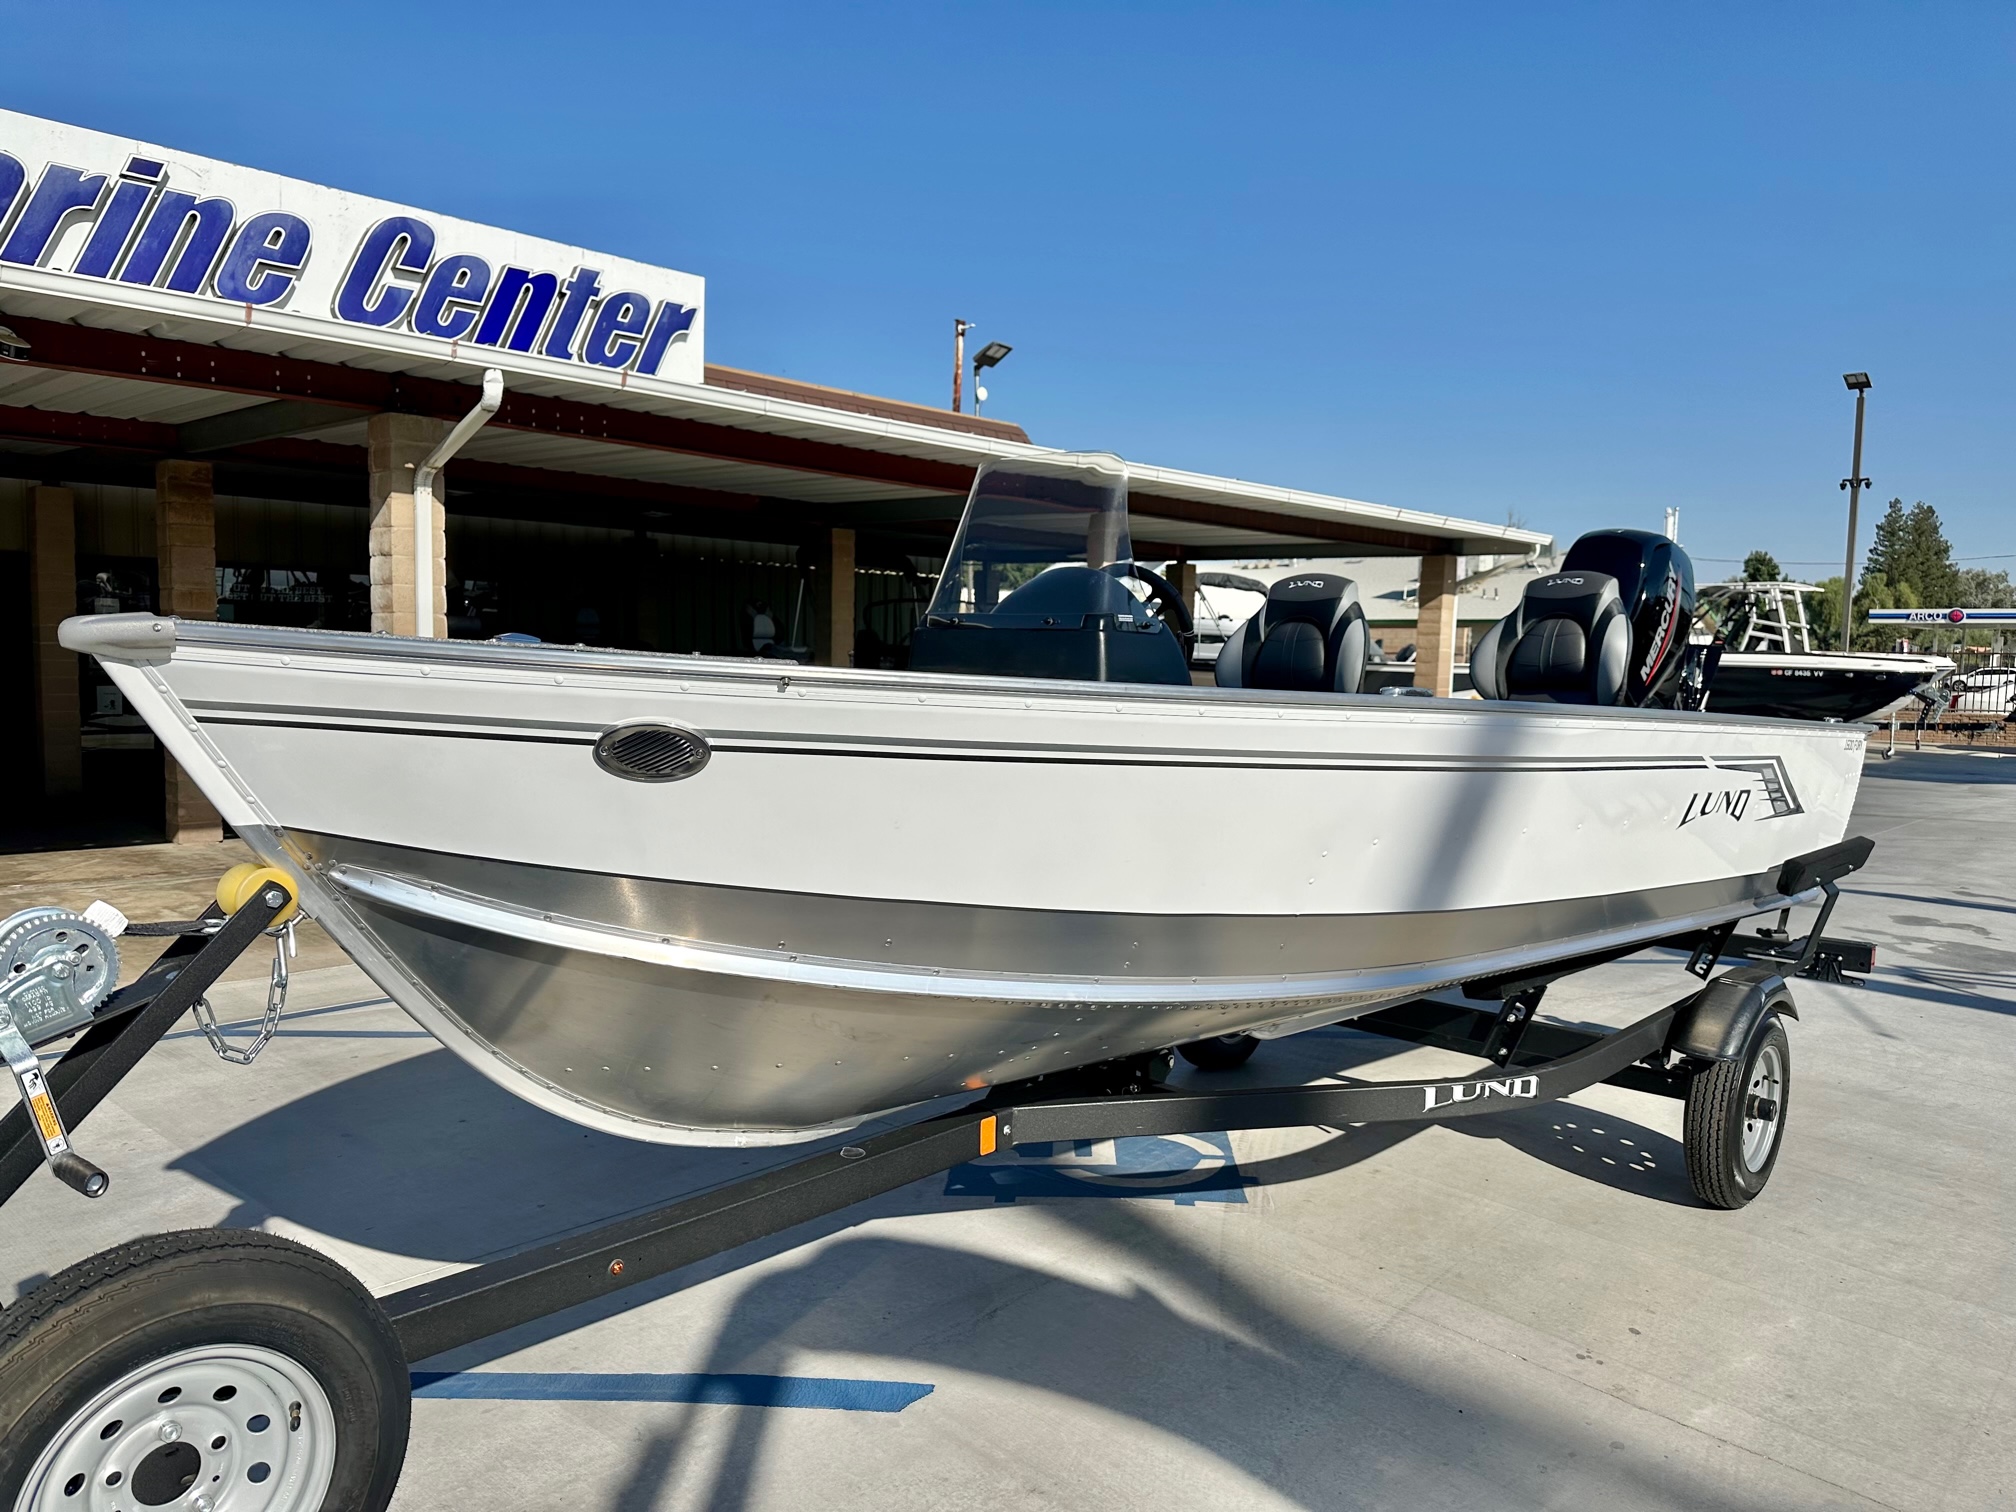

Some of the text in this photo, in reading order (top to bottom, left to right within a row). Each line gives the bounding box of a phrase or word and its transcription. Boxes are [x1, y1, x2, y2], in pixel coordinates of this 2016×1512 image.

[333, 214, 698, 377] Center
[1288, 580, 1324, 589] LUND
[1547, 577, 1584, 586] LUND
[1639, 561, 1678, 682] MERCURY
[1908, 612, 1942, 621] ARCO
[1676, 789, 1752, 830] LUND
[1422, 1075, 1540, 1113] LUND
